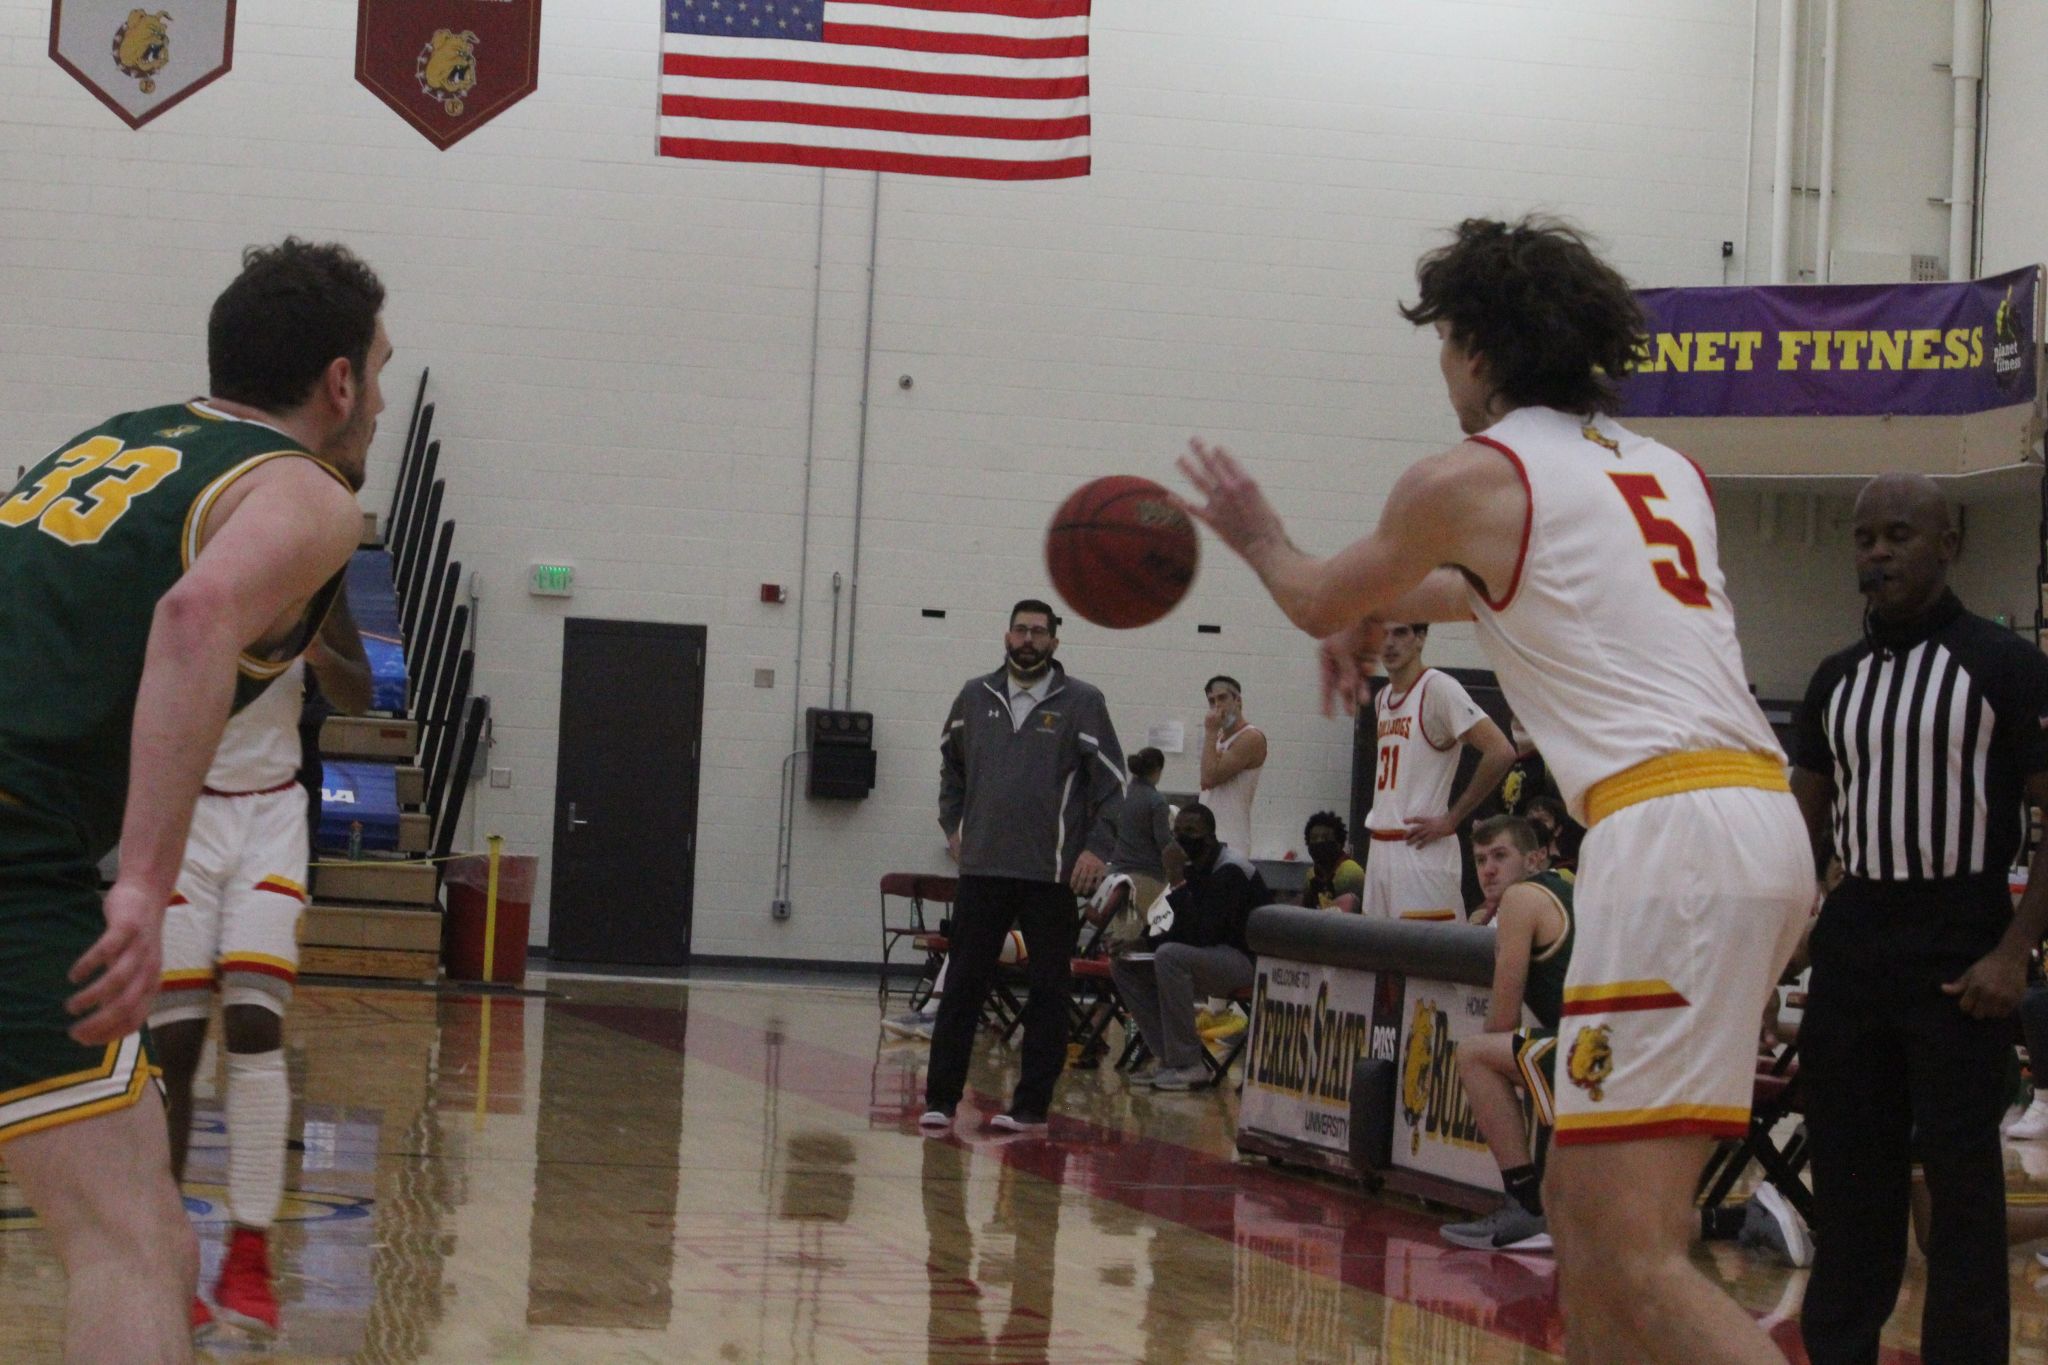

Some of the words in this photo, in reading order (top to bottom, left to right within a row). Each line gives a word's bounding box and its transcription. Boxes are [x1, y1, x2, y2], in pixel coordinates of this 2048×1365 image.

[1777, 326, 1984, 372] FITNESS
[1994, 340, 2018, 363] planet
[0, 435, 183, 547] 33
[1604, 470, 1714, 609] 5
[1377, 745, 1400, 791] 31
[1271, 967, 1301, 987] WELCOME
[1465, 996, 1489, 1017] HOME
[1372, 1026, 1396, 1061] POSS
[1304, 1111, 1348, 1139] UNIVERSITY
